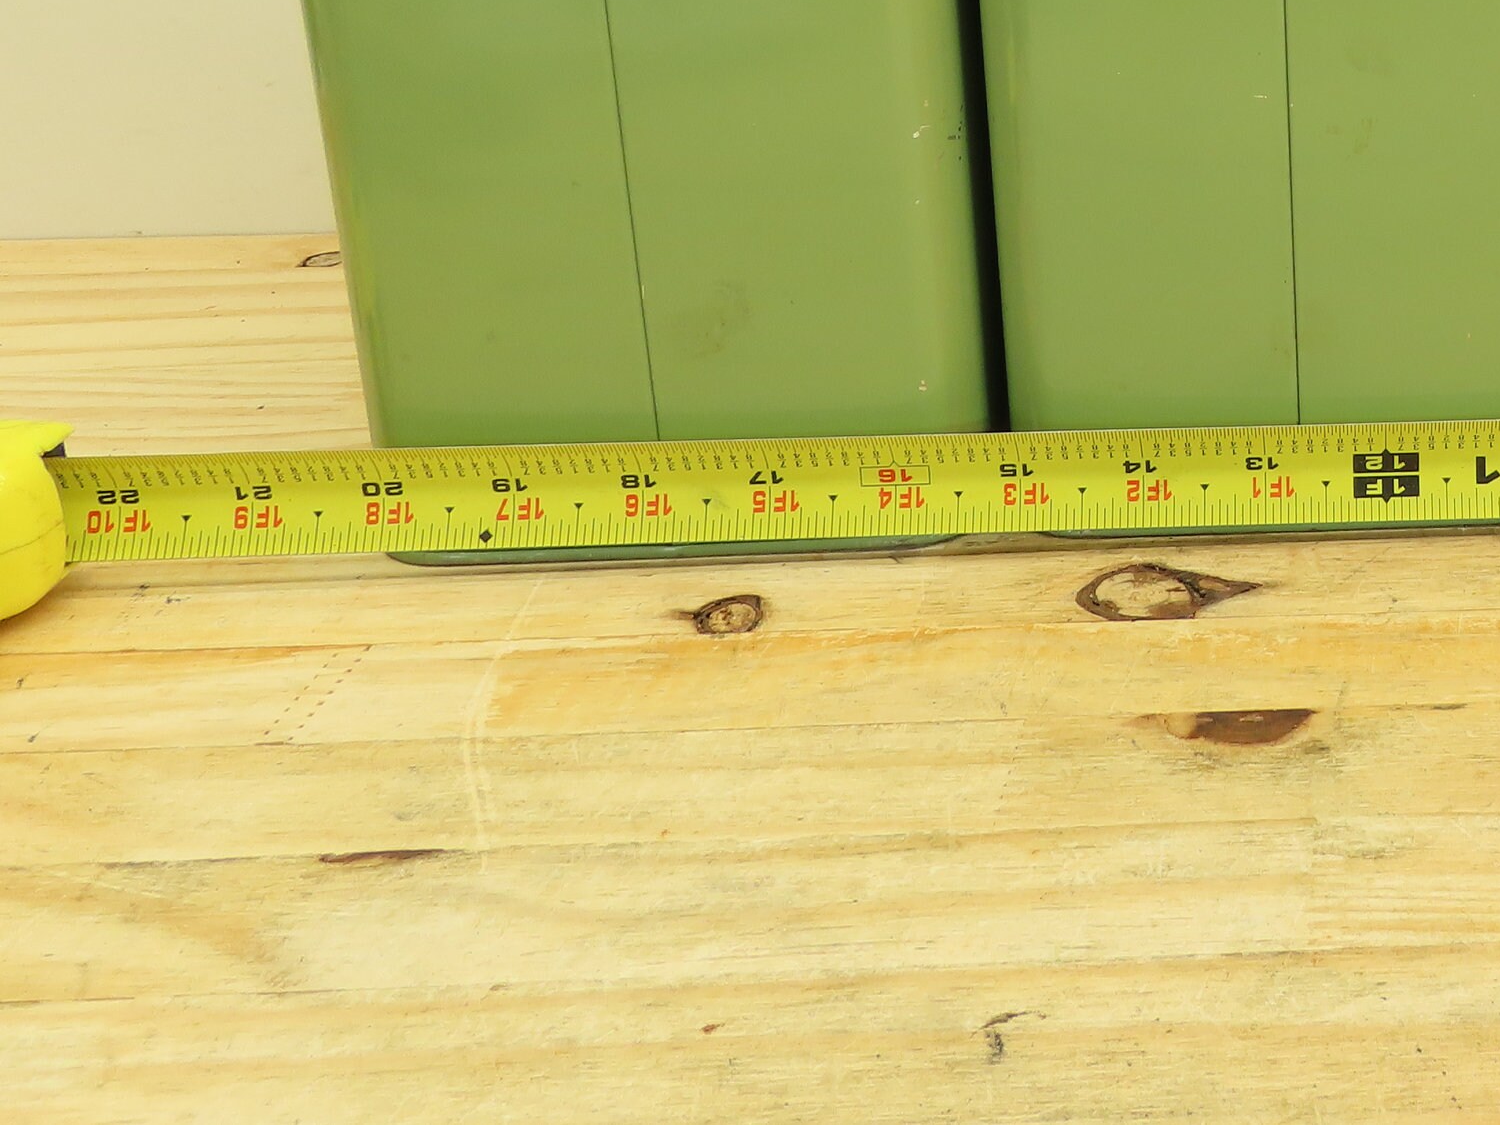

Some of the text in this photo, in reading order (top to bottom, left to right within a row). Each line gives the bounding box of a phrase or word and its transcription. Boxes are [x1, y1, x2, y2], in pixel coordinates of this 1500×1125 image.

[1122, 459, 1158, 474] 14
[1245, 456, 1279, 471] 13
[1364, 455, 1406, 470] 12
[749, 470, 784, 485] 17
[878, 468, 913, 484] 16
[999, 463, 1034, 478] 15
[361, 481, 404, 497] 20
[491, 478, 528, 493] 19
[620, 474, 657, 489] 18
[96, 489, 140, 505] 22
[234, 485, 273, 501] 21
